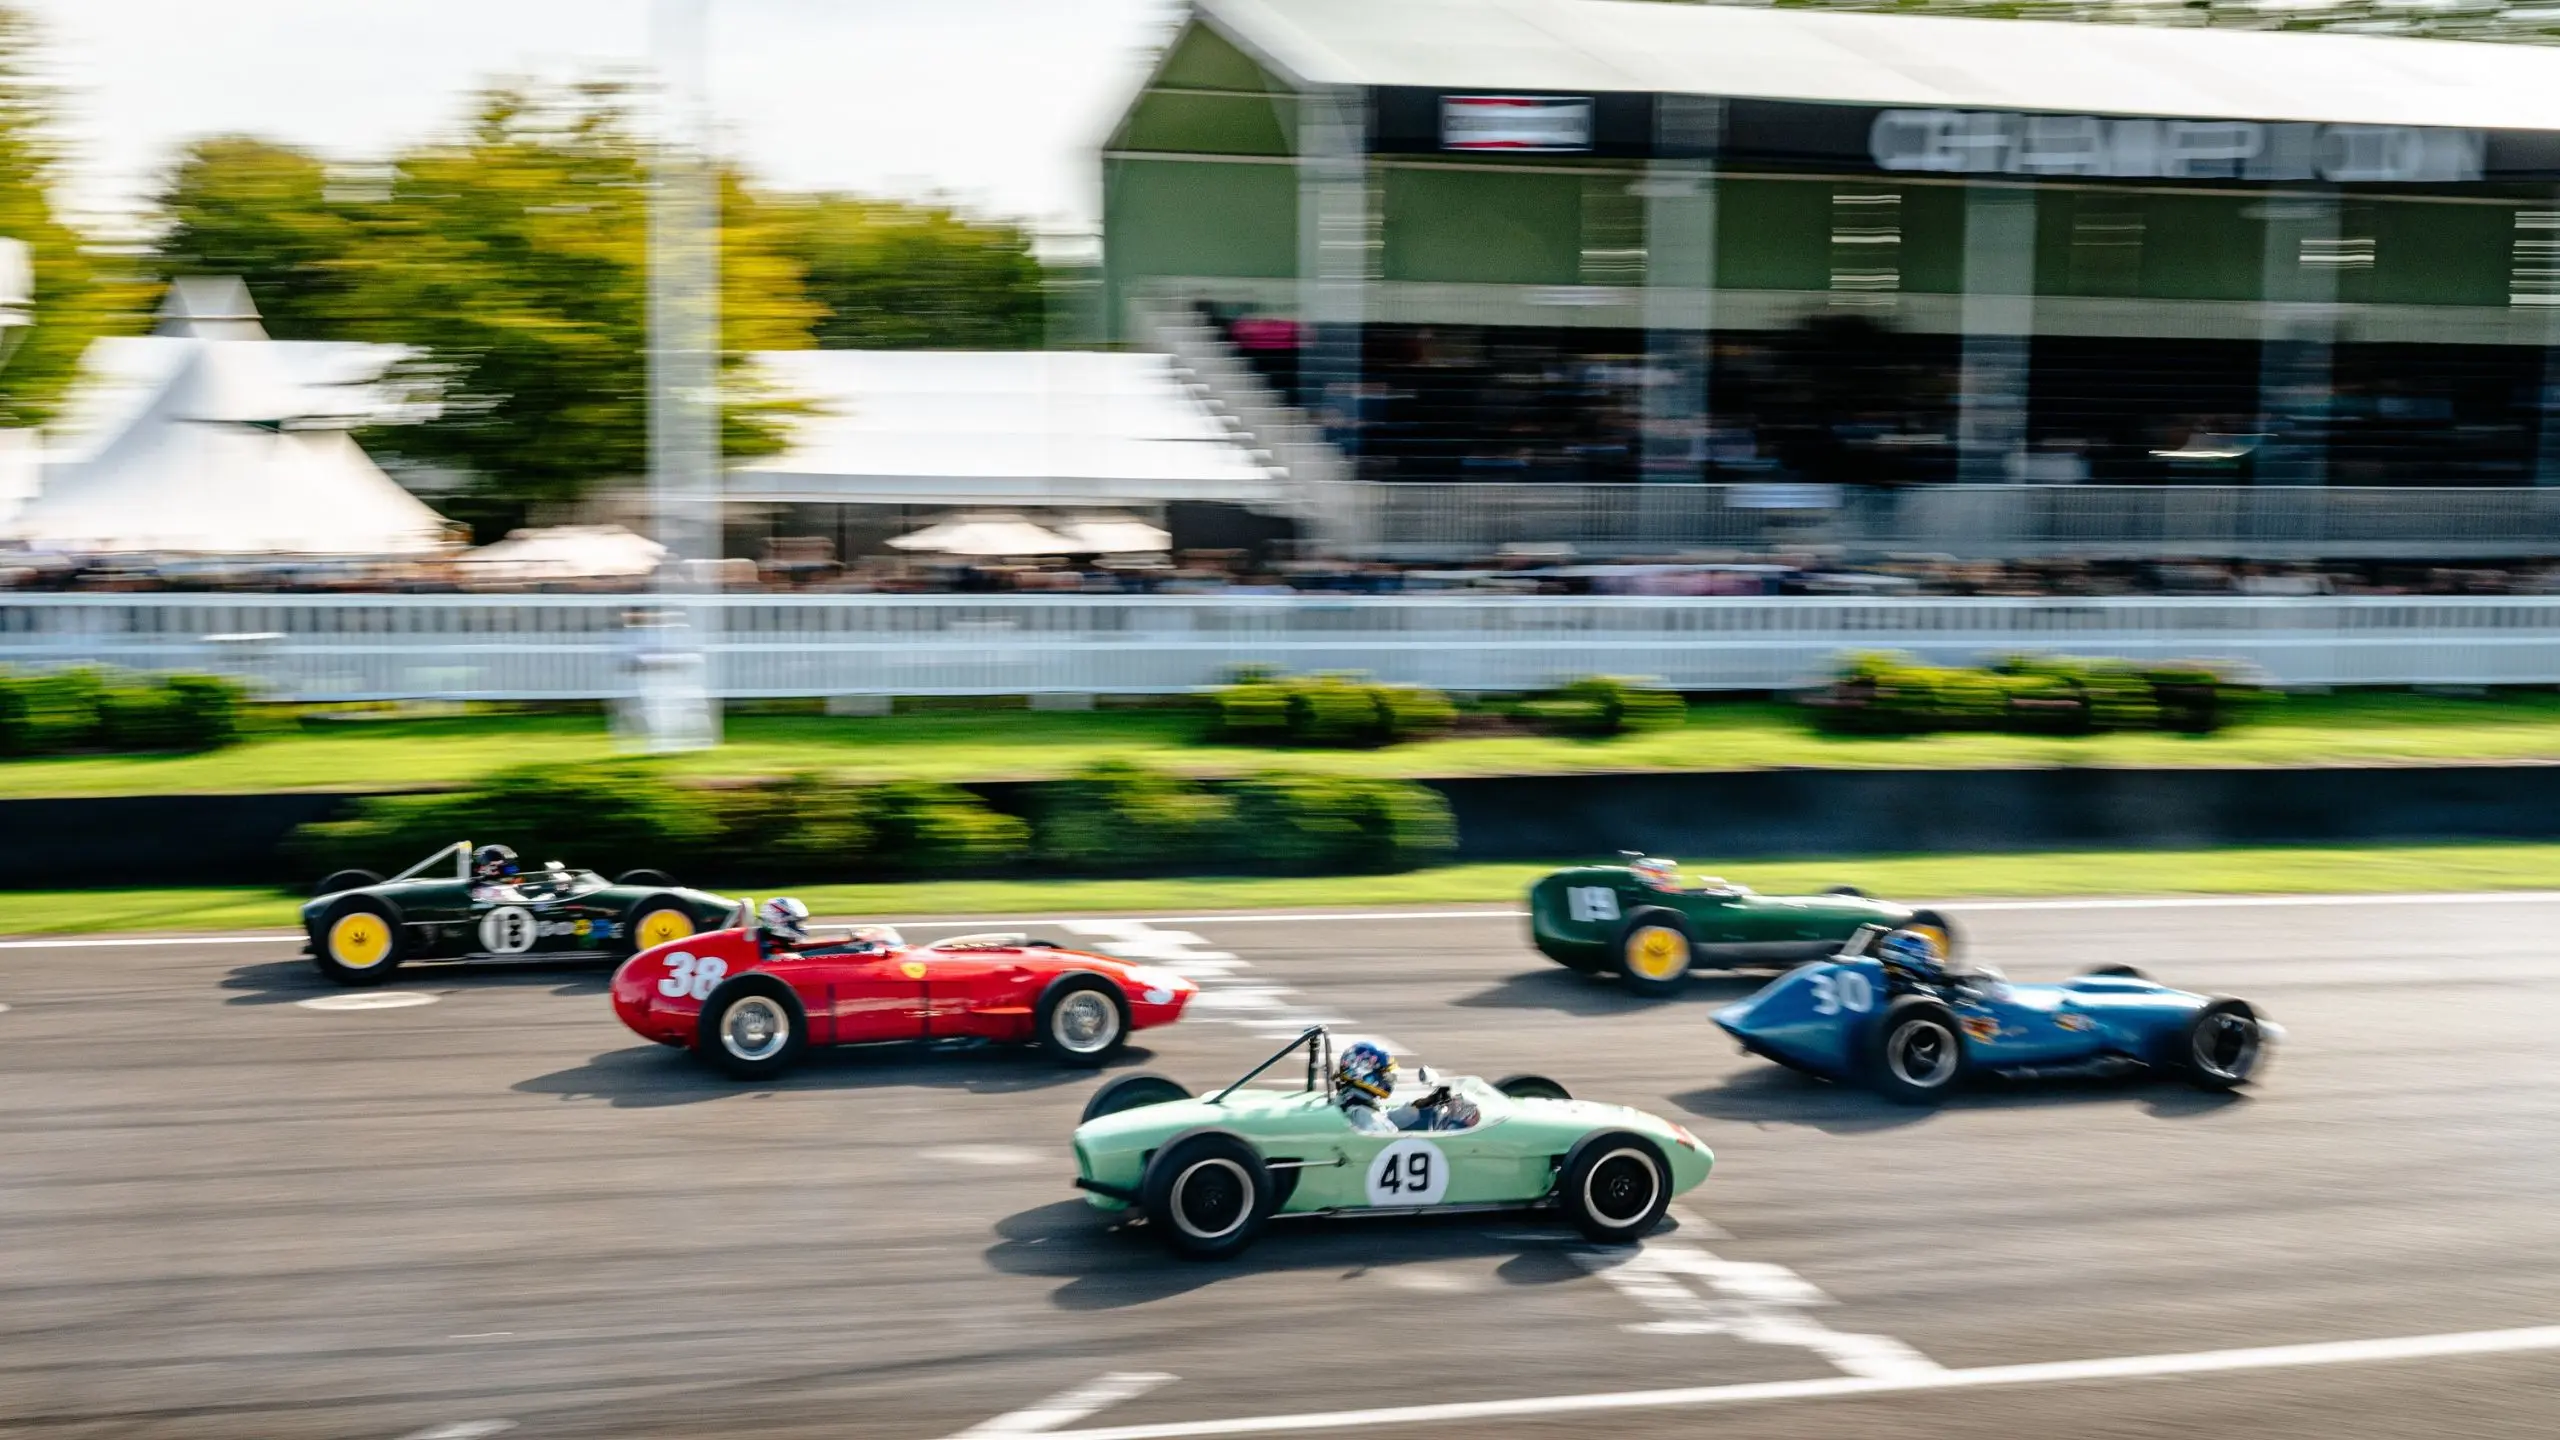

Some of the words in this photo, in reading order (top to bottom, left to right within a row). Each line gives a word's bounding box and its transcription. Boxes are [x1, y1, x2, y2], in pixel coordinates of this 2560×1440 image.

[658, 951, 728, 1001] 38
[1806, 971, 1873, 1016] 30
[1380, 1152, 1430, 1195] 49
